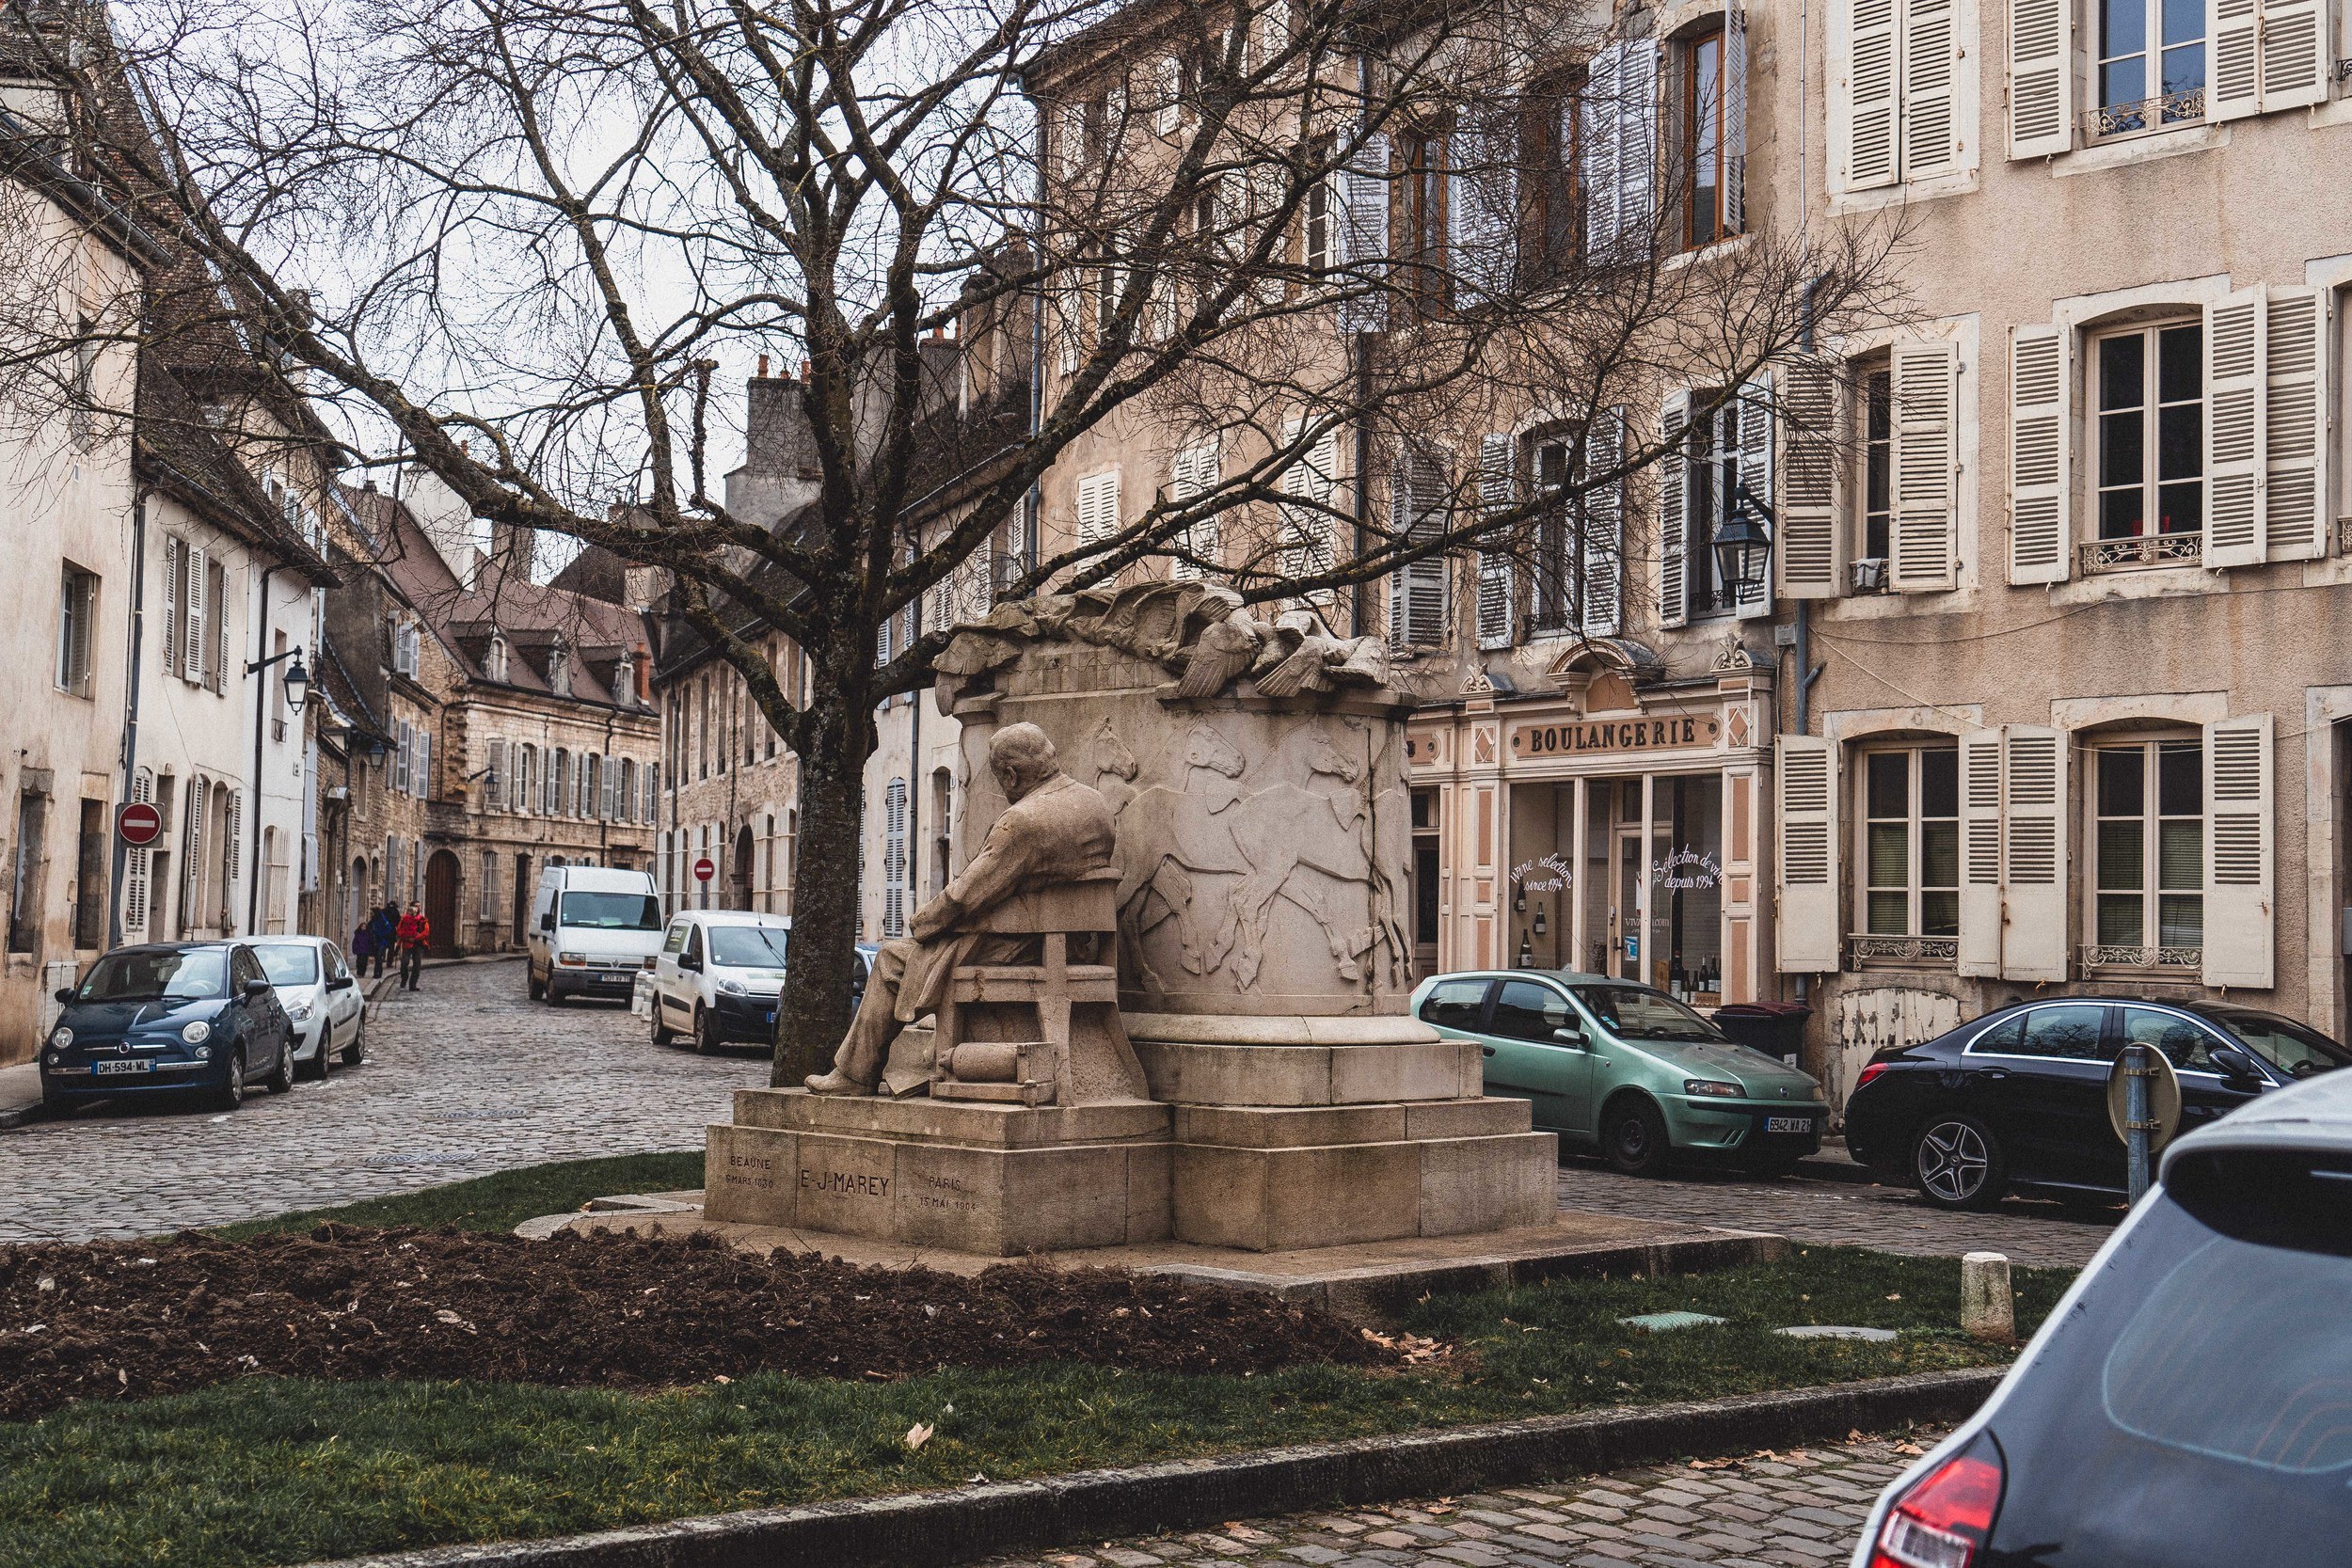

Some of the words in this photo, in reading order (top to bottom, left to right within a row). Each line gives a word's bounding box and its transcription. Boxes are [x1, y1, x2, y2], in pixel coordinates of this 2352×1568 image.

[1530, 719, 1695, 752] BOULANGERIE
[1699, 851, 1712, 868] de
[1537, 852, 1572, 889] selection
[1523, 879, 1547, 892] since
[1548, 877, 1563, 893] 1994
[1664, 869, 1694, 895] depuis
[1695, 874, 1714, 890] 1994
[730, 1155, 771, 1170] BEAUNE
[929, 1176, 961, 1192] PARIS
